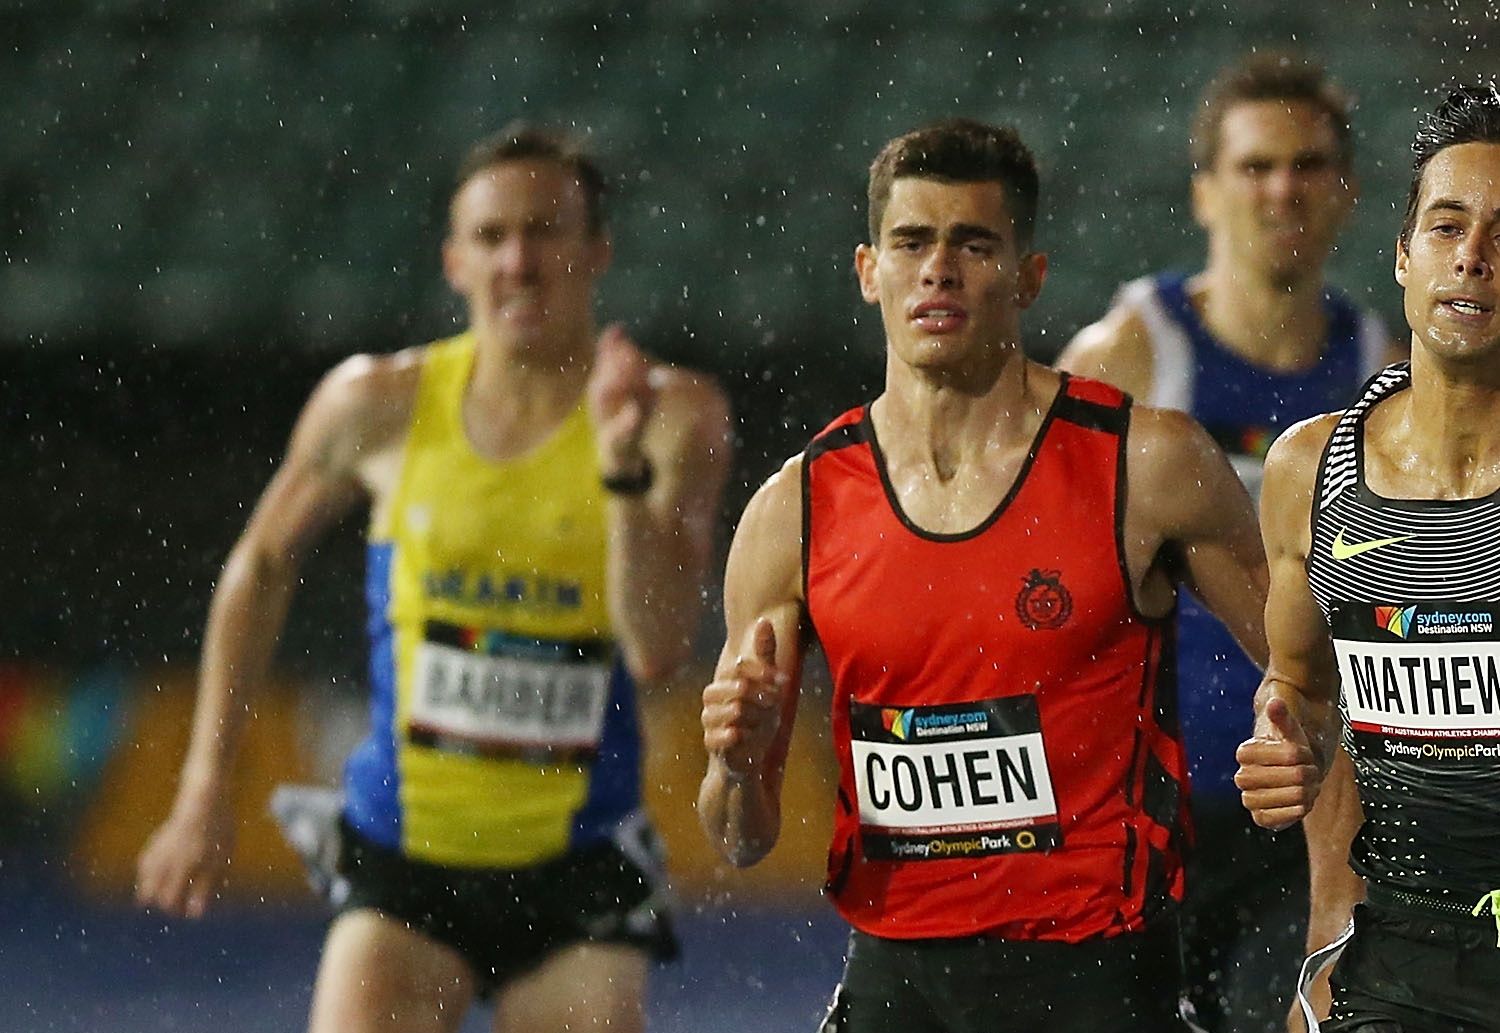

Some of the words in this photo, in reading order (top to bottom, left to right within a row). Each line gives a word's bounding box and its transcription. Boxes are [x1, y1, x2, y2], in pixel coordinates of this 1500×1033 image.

[1416, 611, 1492, 626] sydney.com
[1417, 624, 1469, 634] Destination
[1470, 623, 1493, 633] NSW
[915, 711, 987, 728] sydney.com
[916, 724, 965, 737] Destination
[965, 721, 988, 732] NSW
[1394, 728, 1434, 737] AUSTRALIAN
[866, 746, 1038, 812] COHEN
